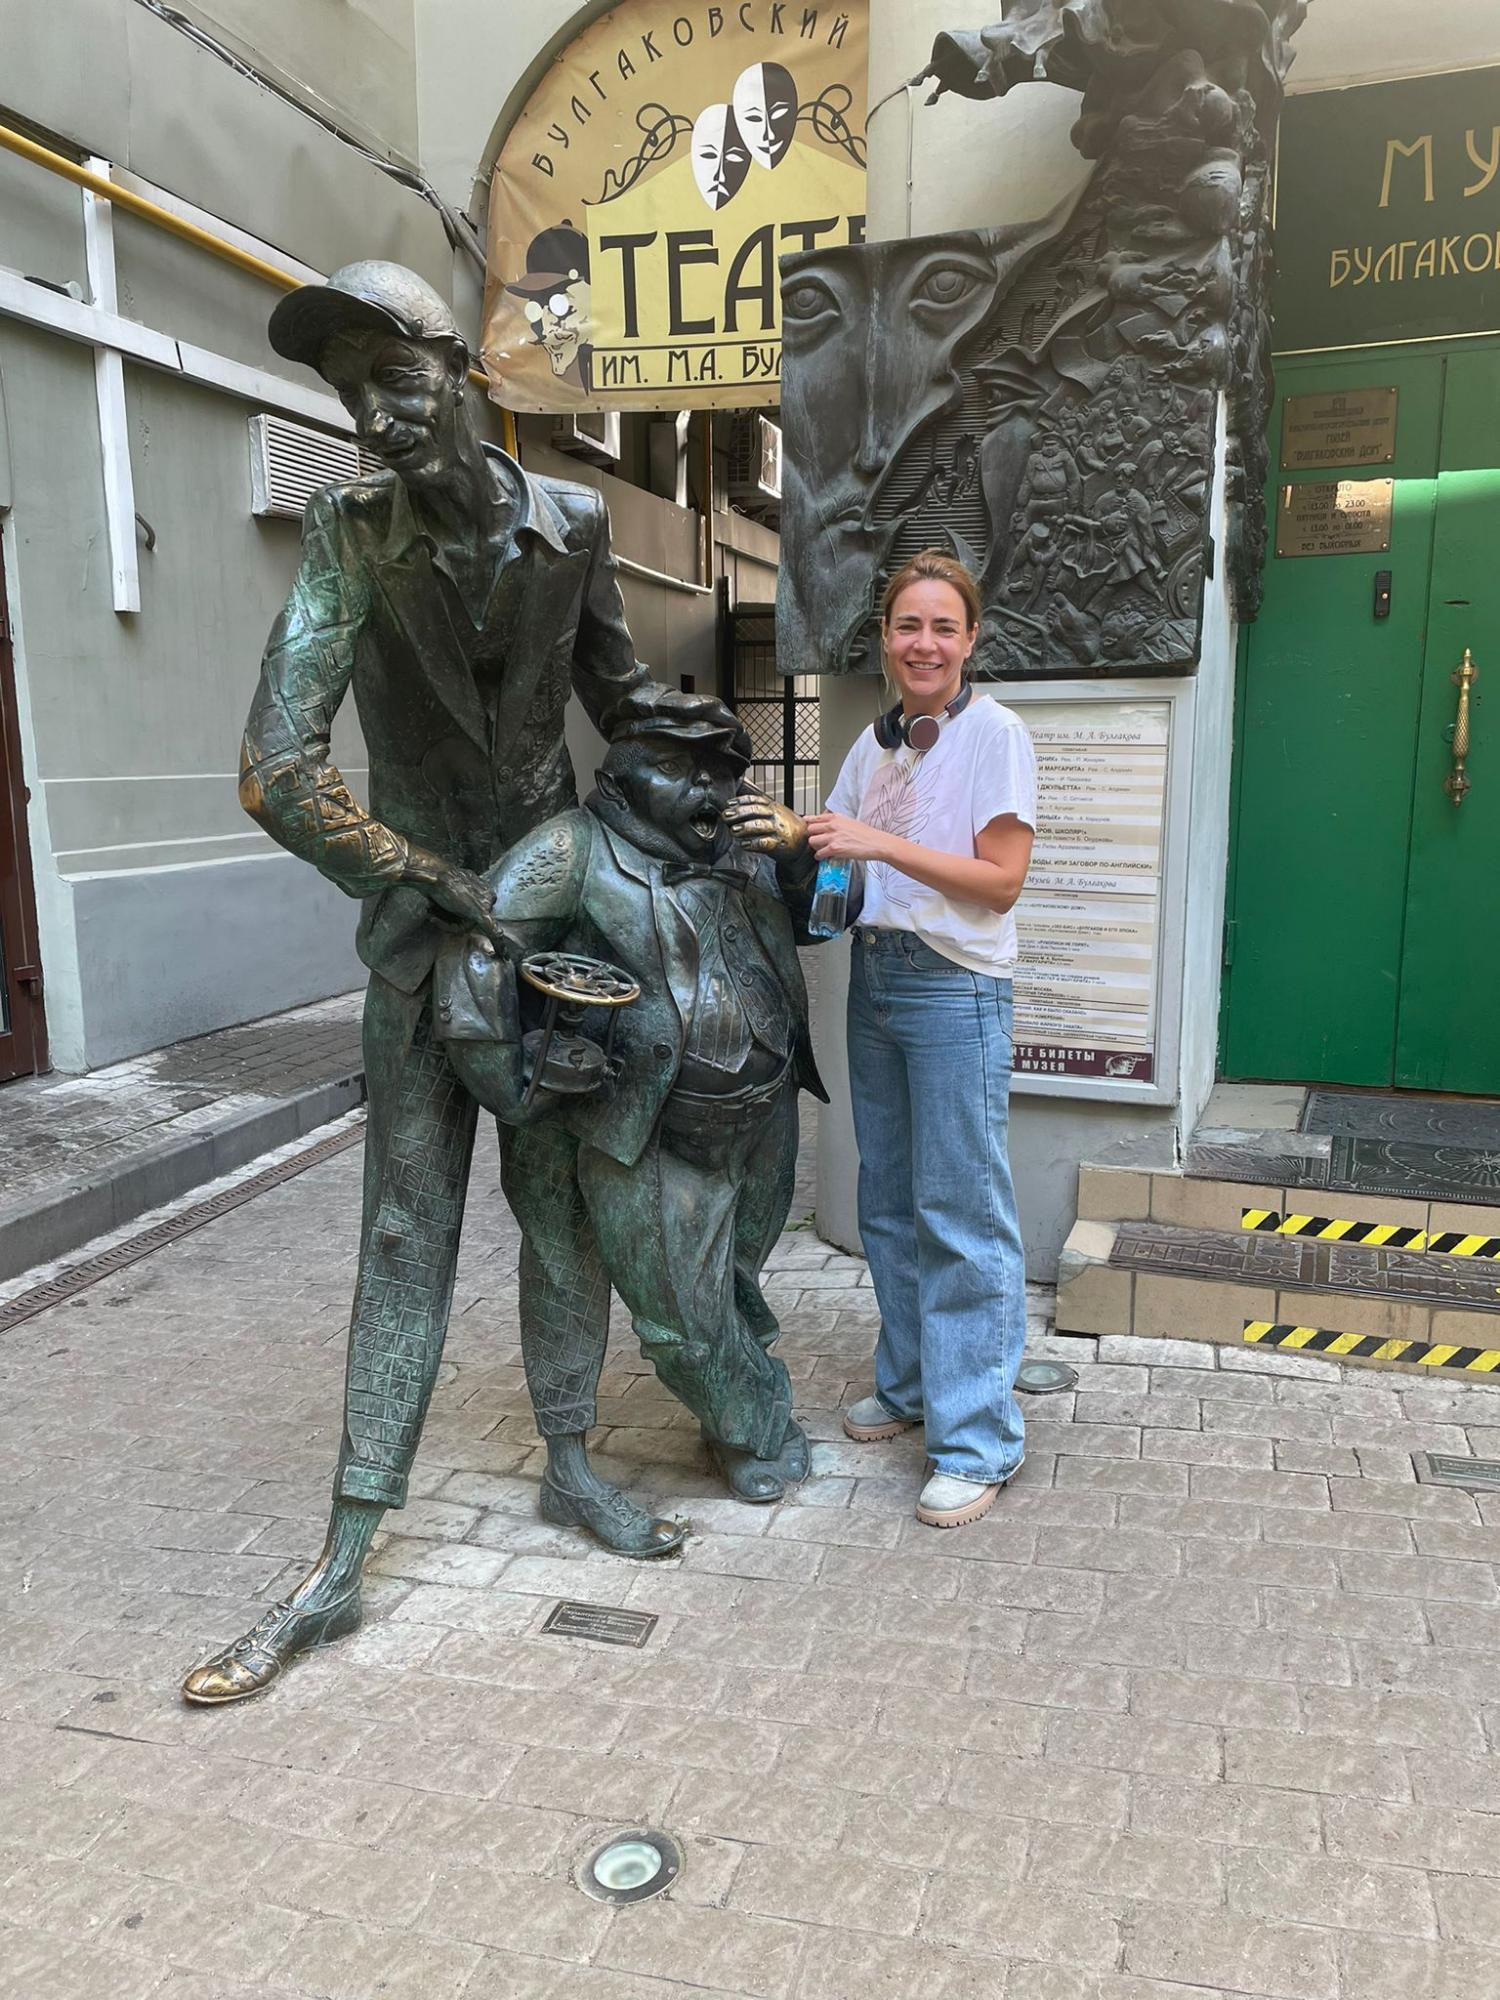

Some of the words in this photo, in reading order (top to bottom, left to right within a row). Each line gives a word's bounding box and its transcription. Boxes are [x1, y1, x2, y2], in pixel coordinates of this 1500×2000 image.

[531, 3, 849, 178] БУЛГАКОВСКИЙ
[600, 215, 866, 338] ТЕАТ
[602, 353, 648, 386] ИМ.
[1022, 1060, 1065, 1071] МУЗЕЯ
[1040, 1048, 1095, 1061] БИЛЕТЫ
